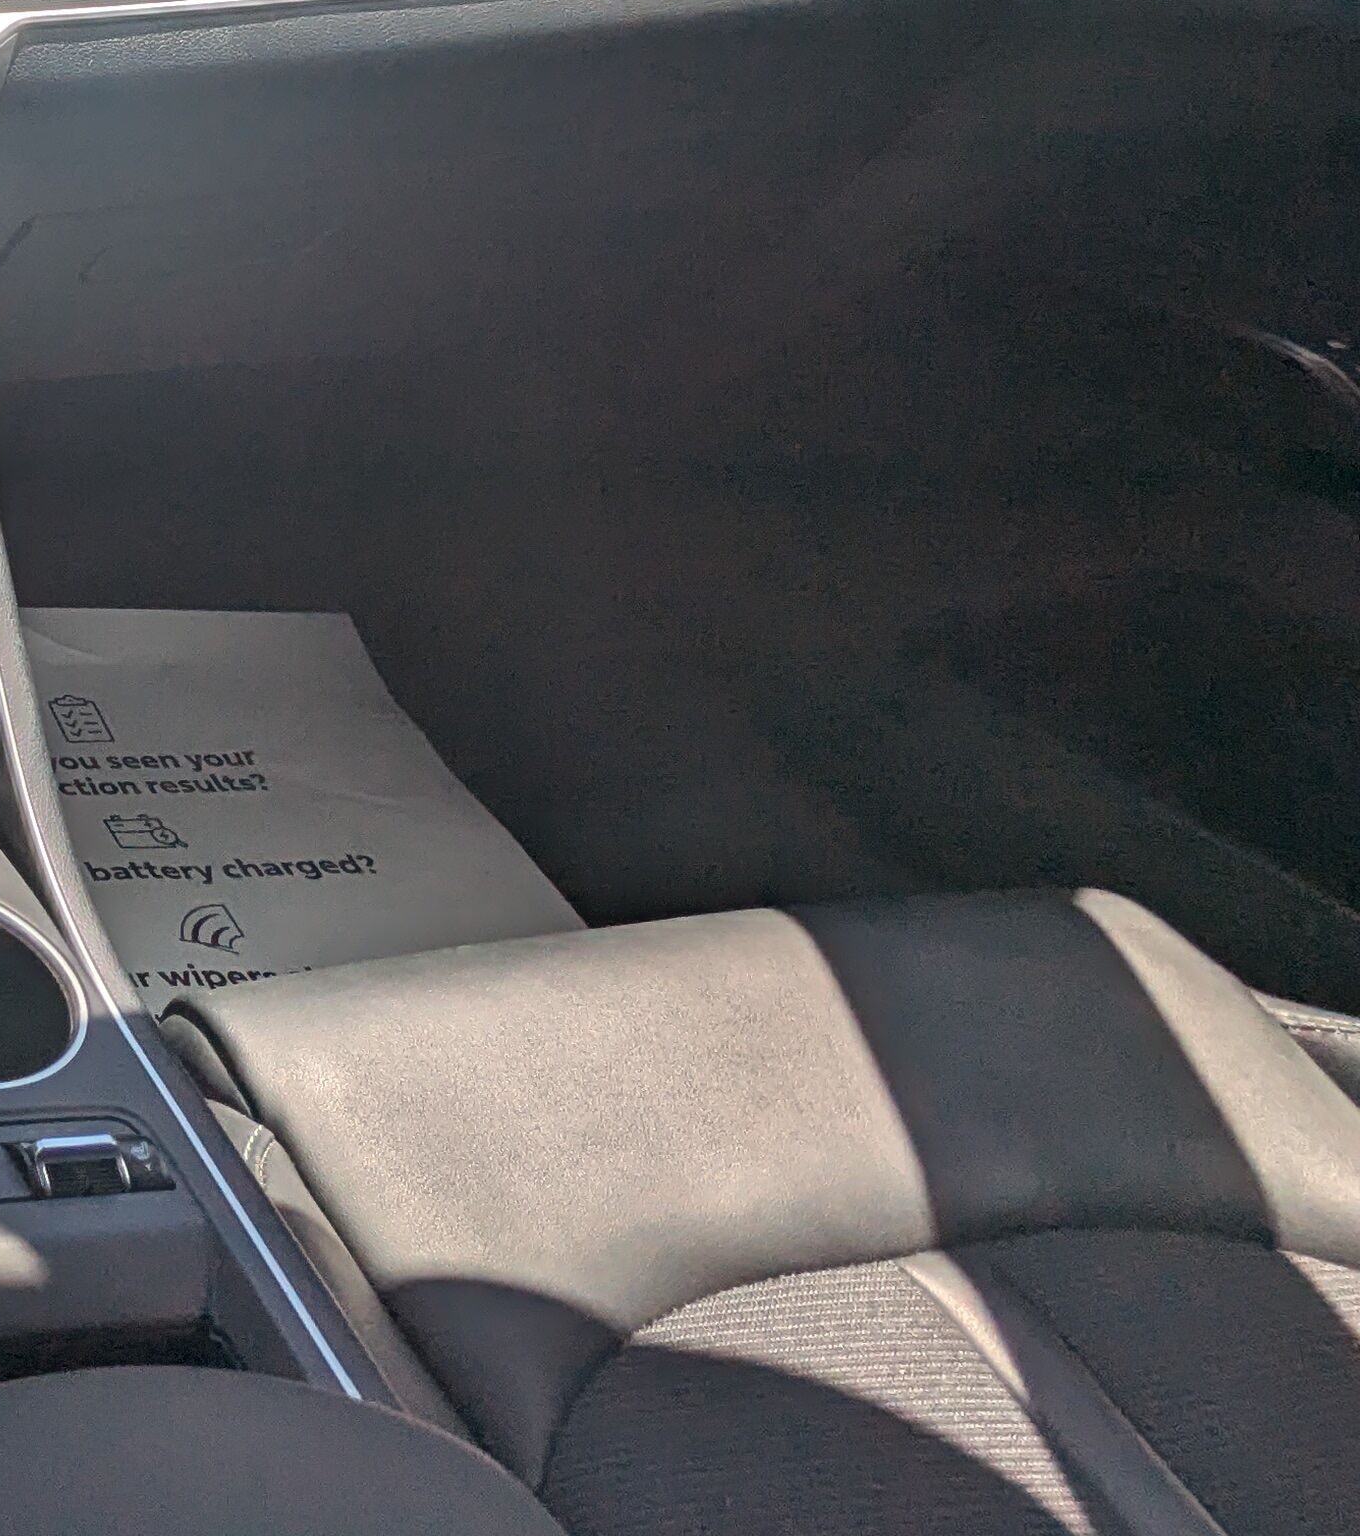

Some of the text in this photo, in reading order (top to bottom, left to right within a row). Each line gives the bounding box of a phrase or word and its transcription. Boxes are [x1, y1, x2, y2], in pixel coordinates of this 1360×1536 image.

[107, 750, 181, 770] seen
[183, 749, 256, 773] your
[145, 772, 269, 795] results?
[83, 853, 378, 885] battery charged?
